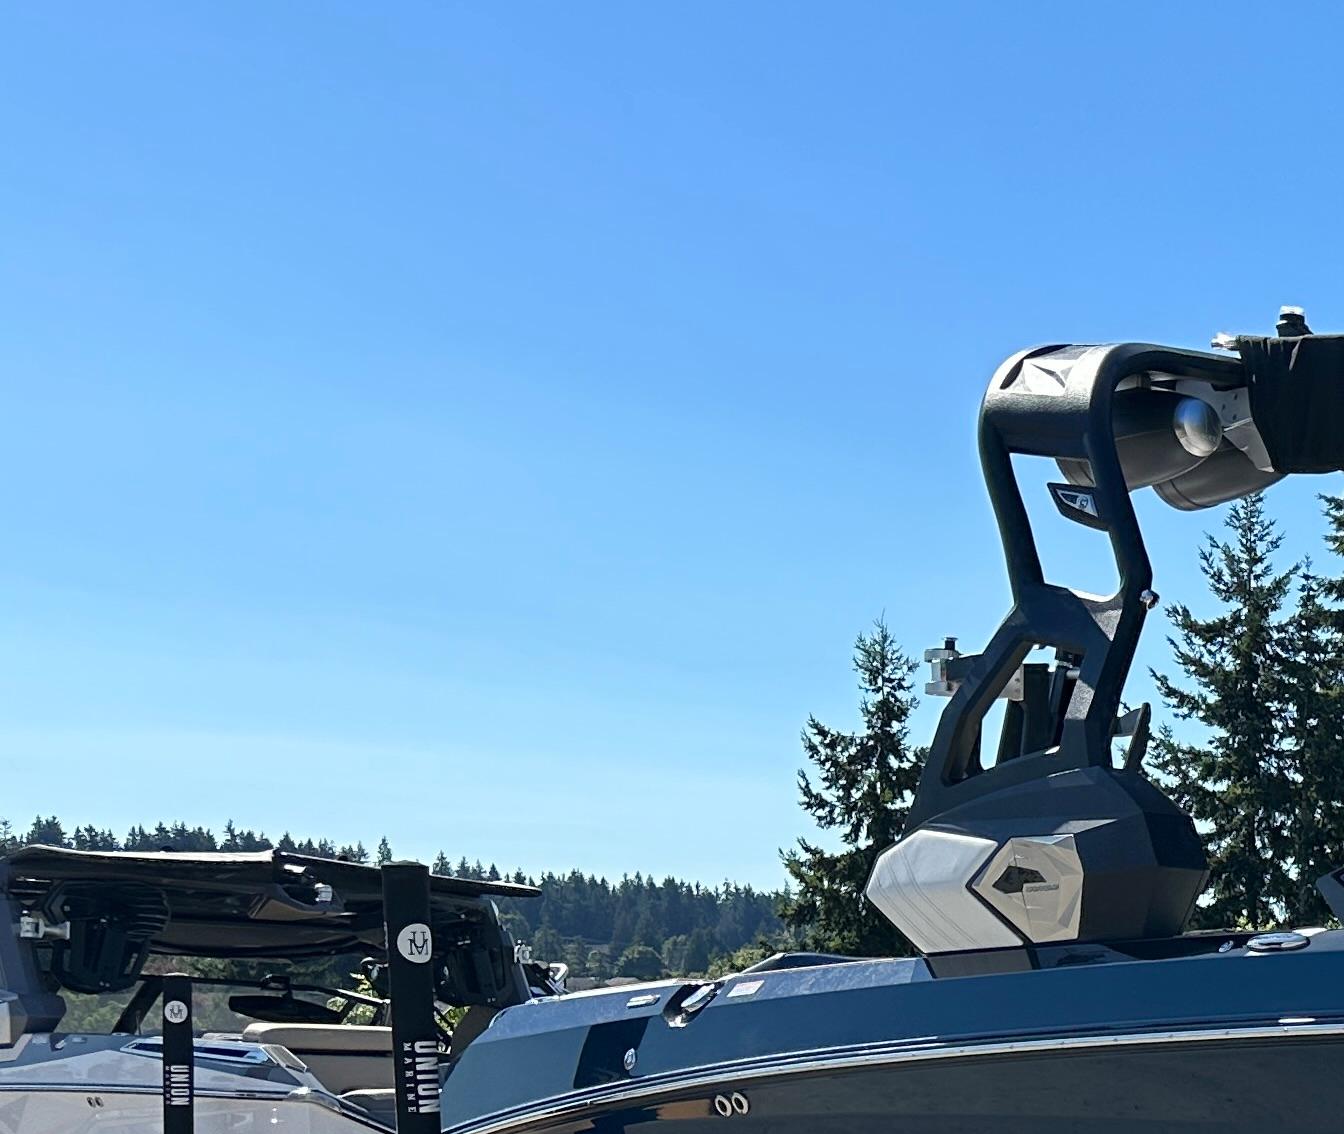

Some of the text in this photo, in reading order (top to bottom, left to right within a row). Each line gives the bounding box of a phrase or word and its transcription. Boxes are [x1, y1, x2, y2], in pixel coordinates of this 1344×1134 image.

[170, 1065, 190, 1105] UNION
[403, 1042, 417, 1113] MARINE
[414, 1040, 441, 1114] UNION
